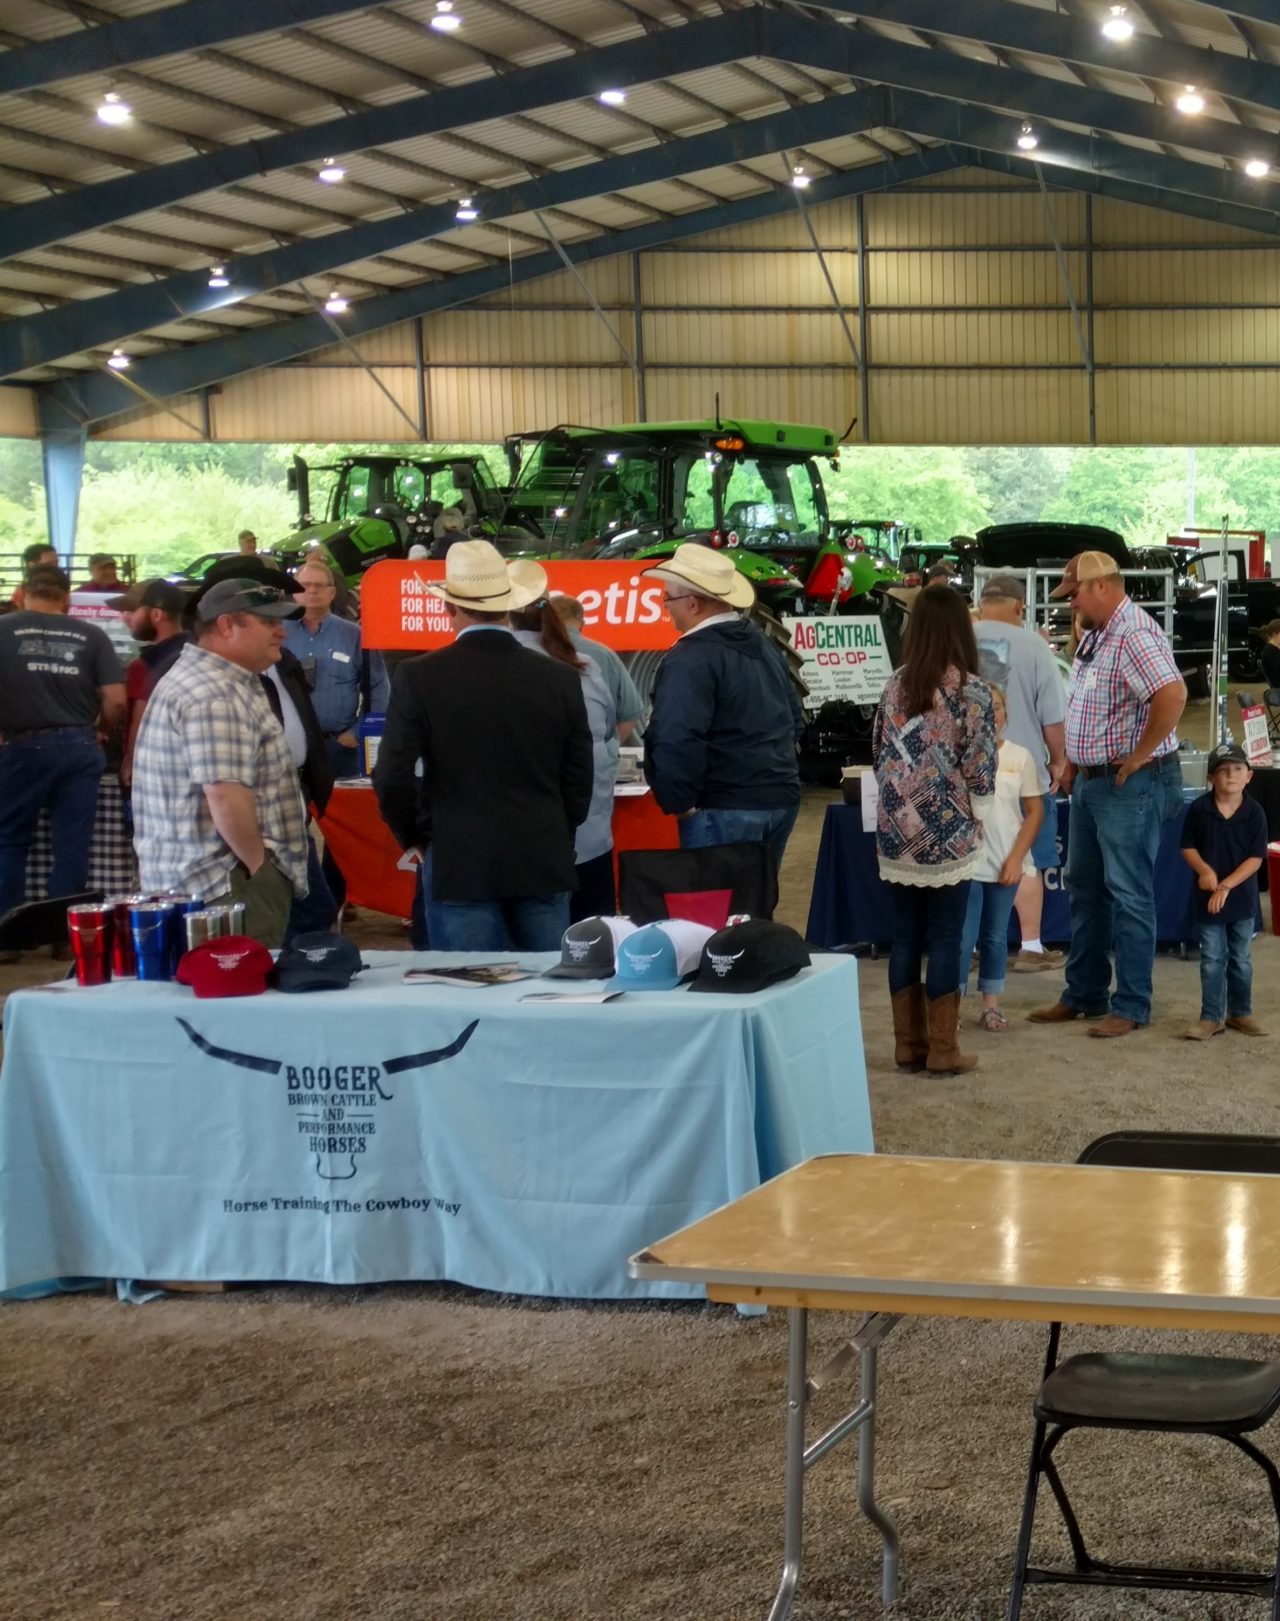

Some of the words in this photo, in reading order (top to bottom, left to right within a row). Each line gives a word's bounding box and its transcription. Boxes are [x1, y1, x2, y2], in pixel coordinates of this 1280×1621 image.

[401, 598, 422, 613] FOR
[425, 598, 446, 613] HEA
[574, 576, 662, 625] etis
[401, 616, 423, 631] FOR
[426, 616, 454, 632] YOU.
[286, 1066, 393, 1100] BOOGER
[288, 1093, 328, 1106] BROWN
[330, 1094, 377, 1107] CATTLE
[321, 1108, 345, 1121] AND
[298, 1122, 376, 1135] PERFORMANCE
[309, 1136, 367, 1154] HORSES
[223, 1199, 268, 1213] Horse
[271, 1197, 330, 1214] Training
[332, 1199, 361, 1213] The
[365, 1196, 431, 1213] Cowboy
[433, 1197, 462, 1216] Way
